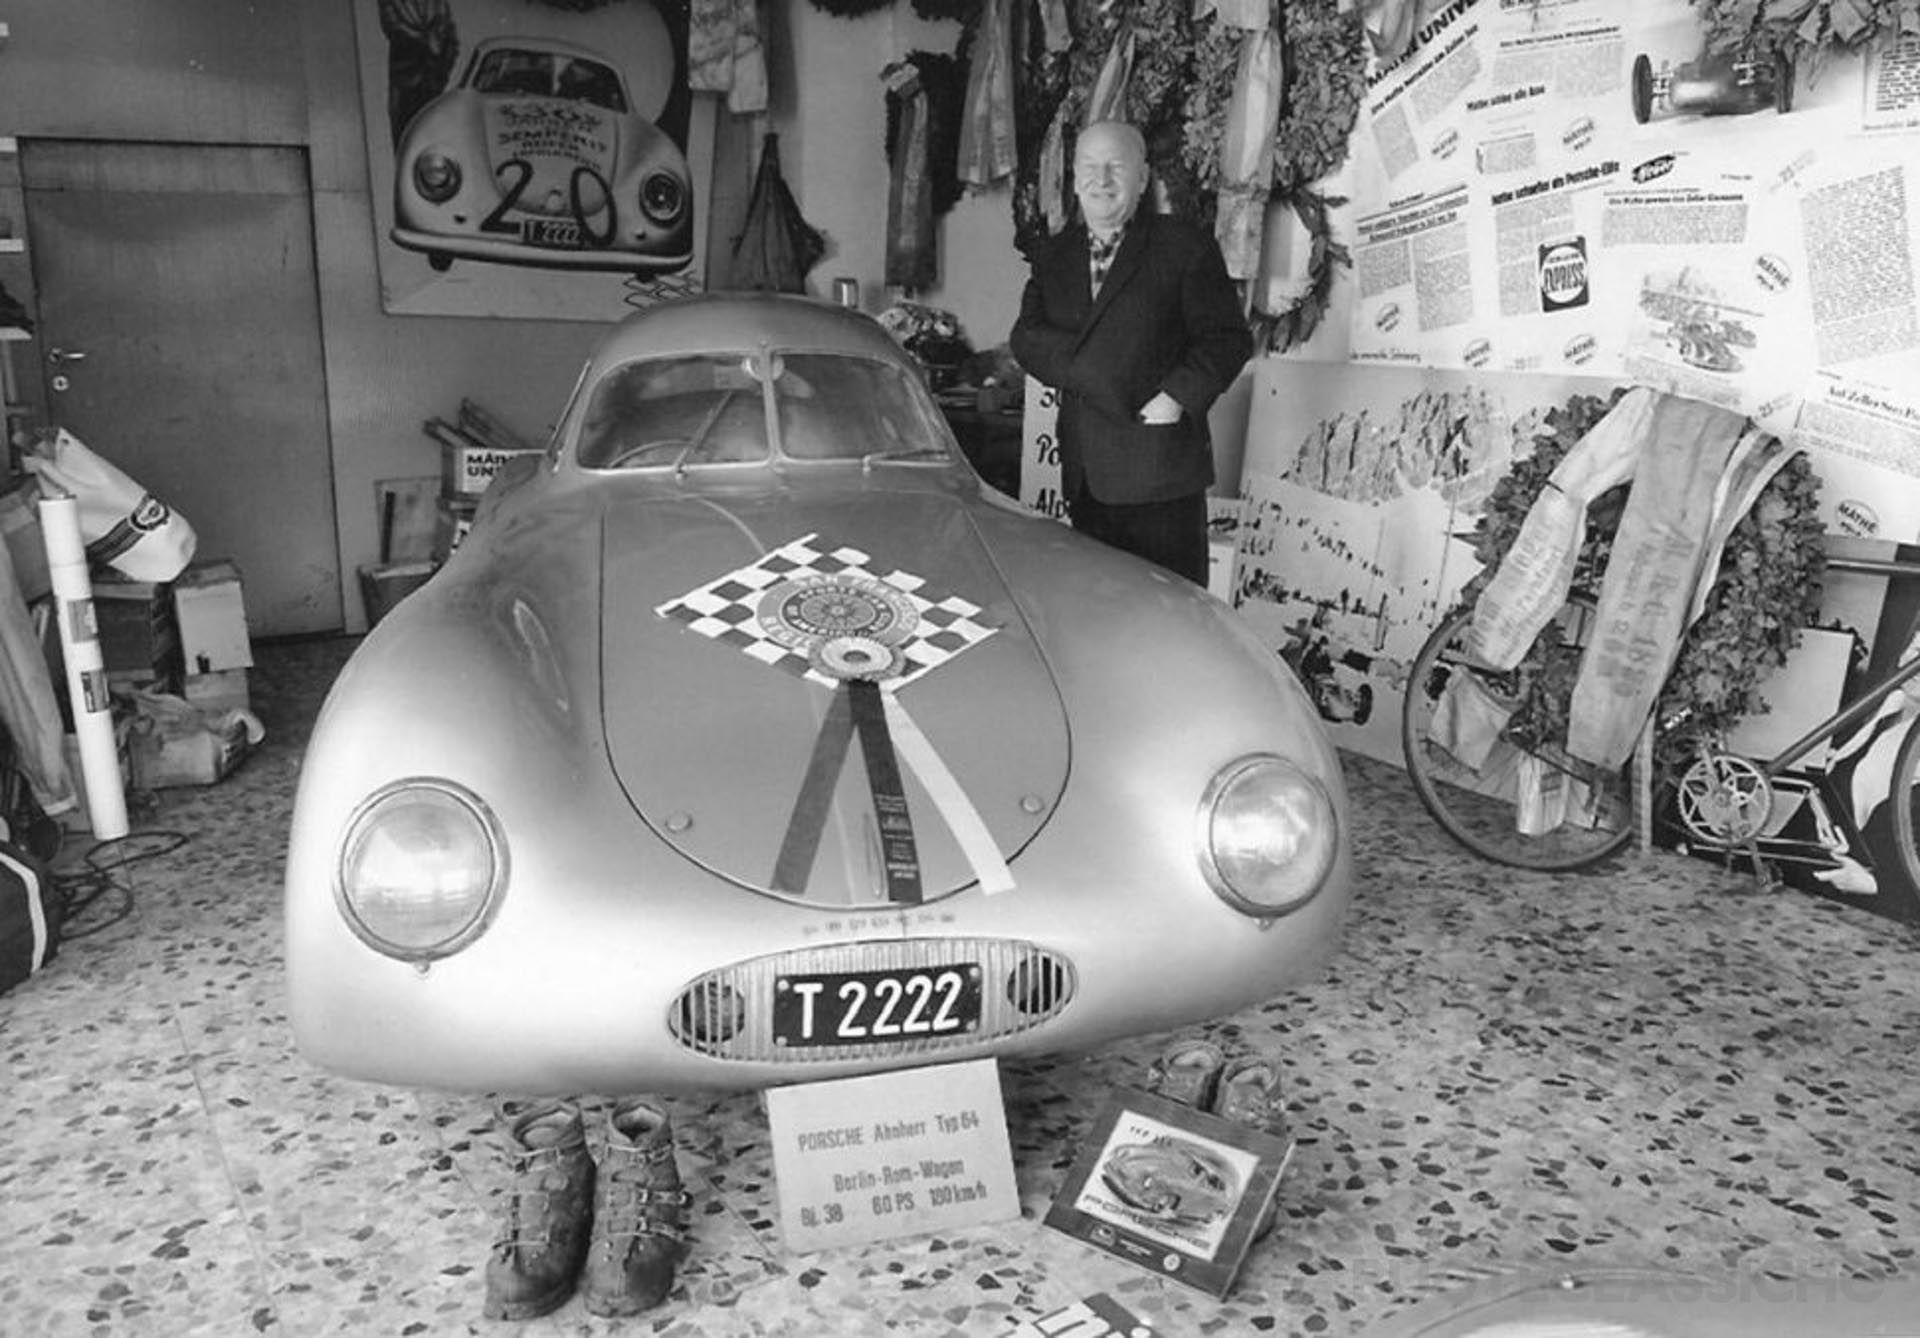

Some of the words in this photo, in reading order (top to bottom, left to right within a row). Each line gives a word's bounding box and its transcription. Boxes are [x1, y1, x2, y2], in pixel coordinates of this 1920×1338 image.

[478, 158, 618, 247] 20
[793, 982, 824, 1039] T
[837, 971, 963, 1038] 2222
[798, 1126, 864, 1151] PORSCHE
[823, 1202, 845, 1224] 38
[895, 1191, 915, 1212] PS
